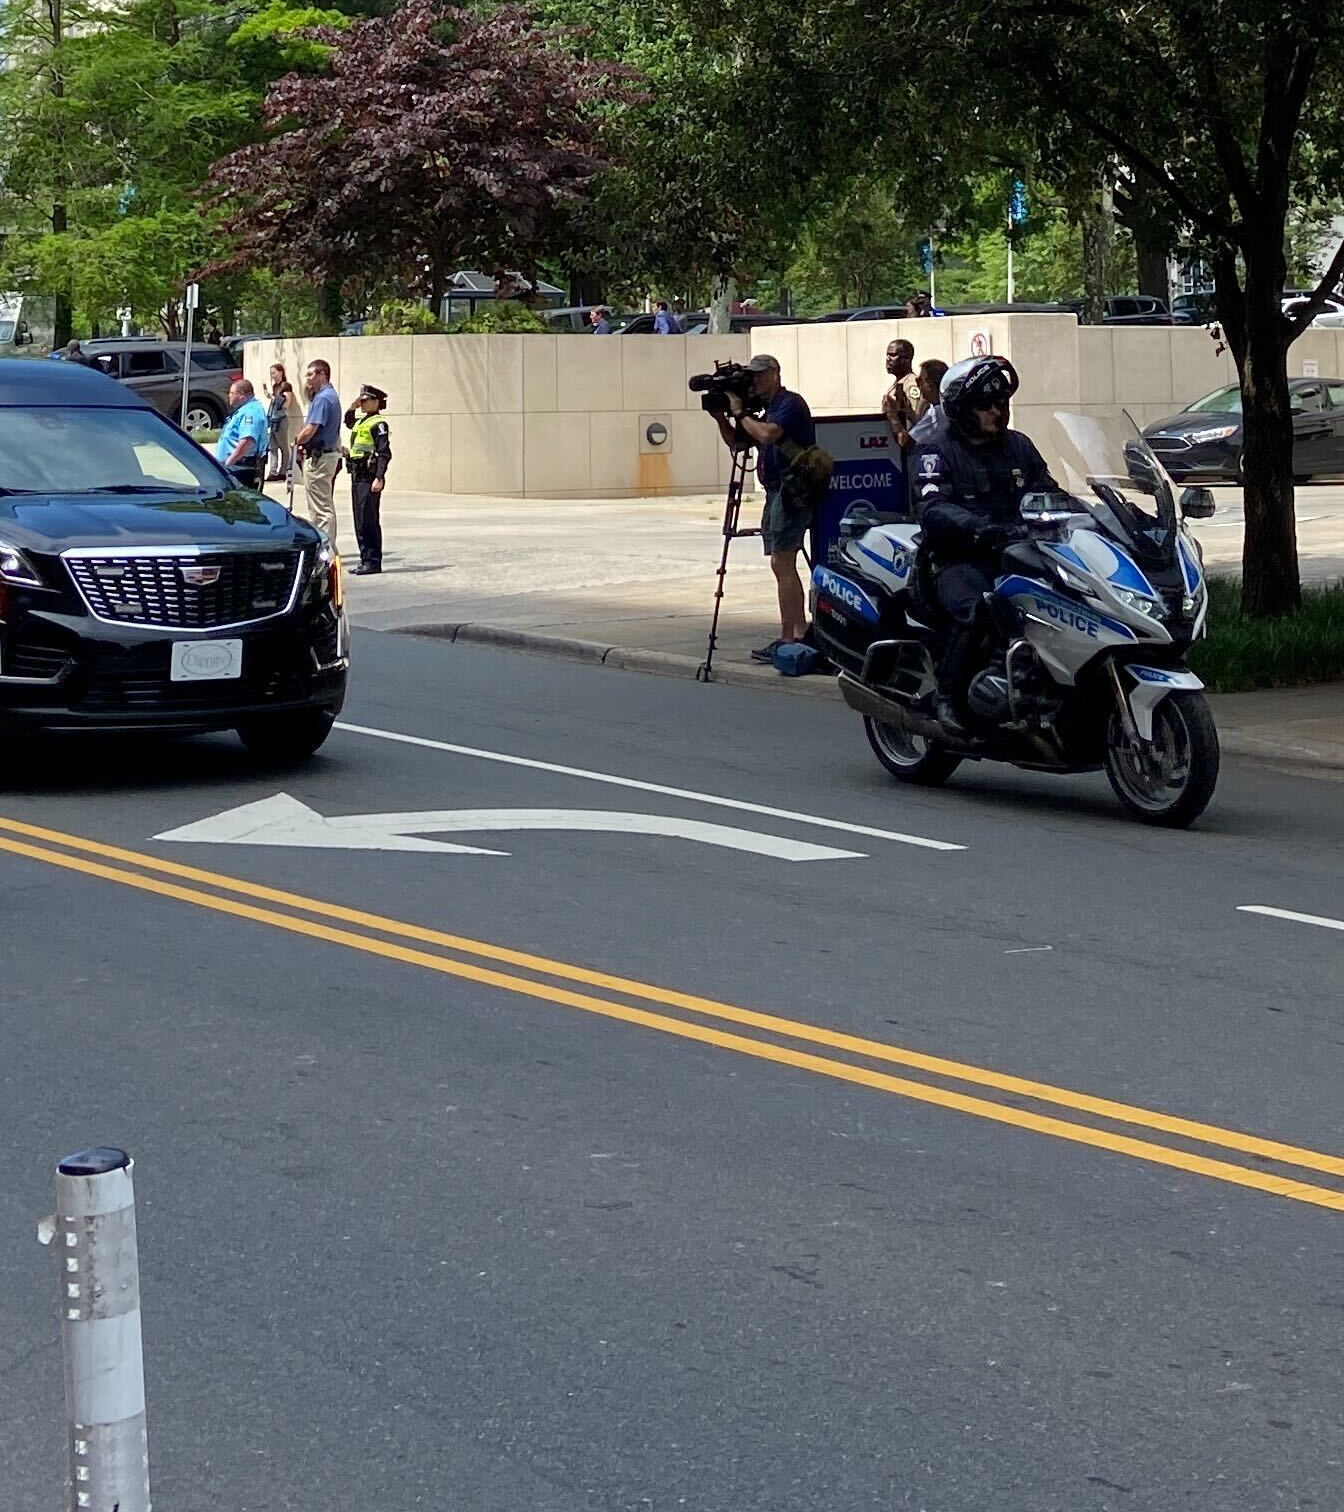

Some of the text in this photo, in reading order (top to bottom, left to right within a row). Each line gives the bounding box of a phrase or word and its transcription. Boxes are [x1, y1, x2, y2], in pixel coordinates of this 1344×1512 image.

[860, 436, 889, 449] LAZ
[822, 572, 862, 612] POLICE
[1033, 597, 1099, 639] POLICE
